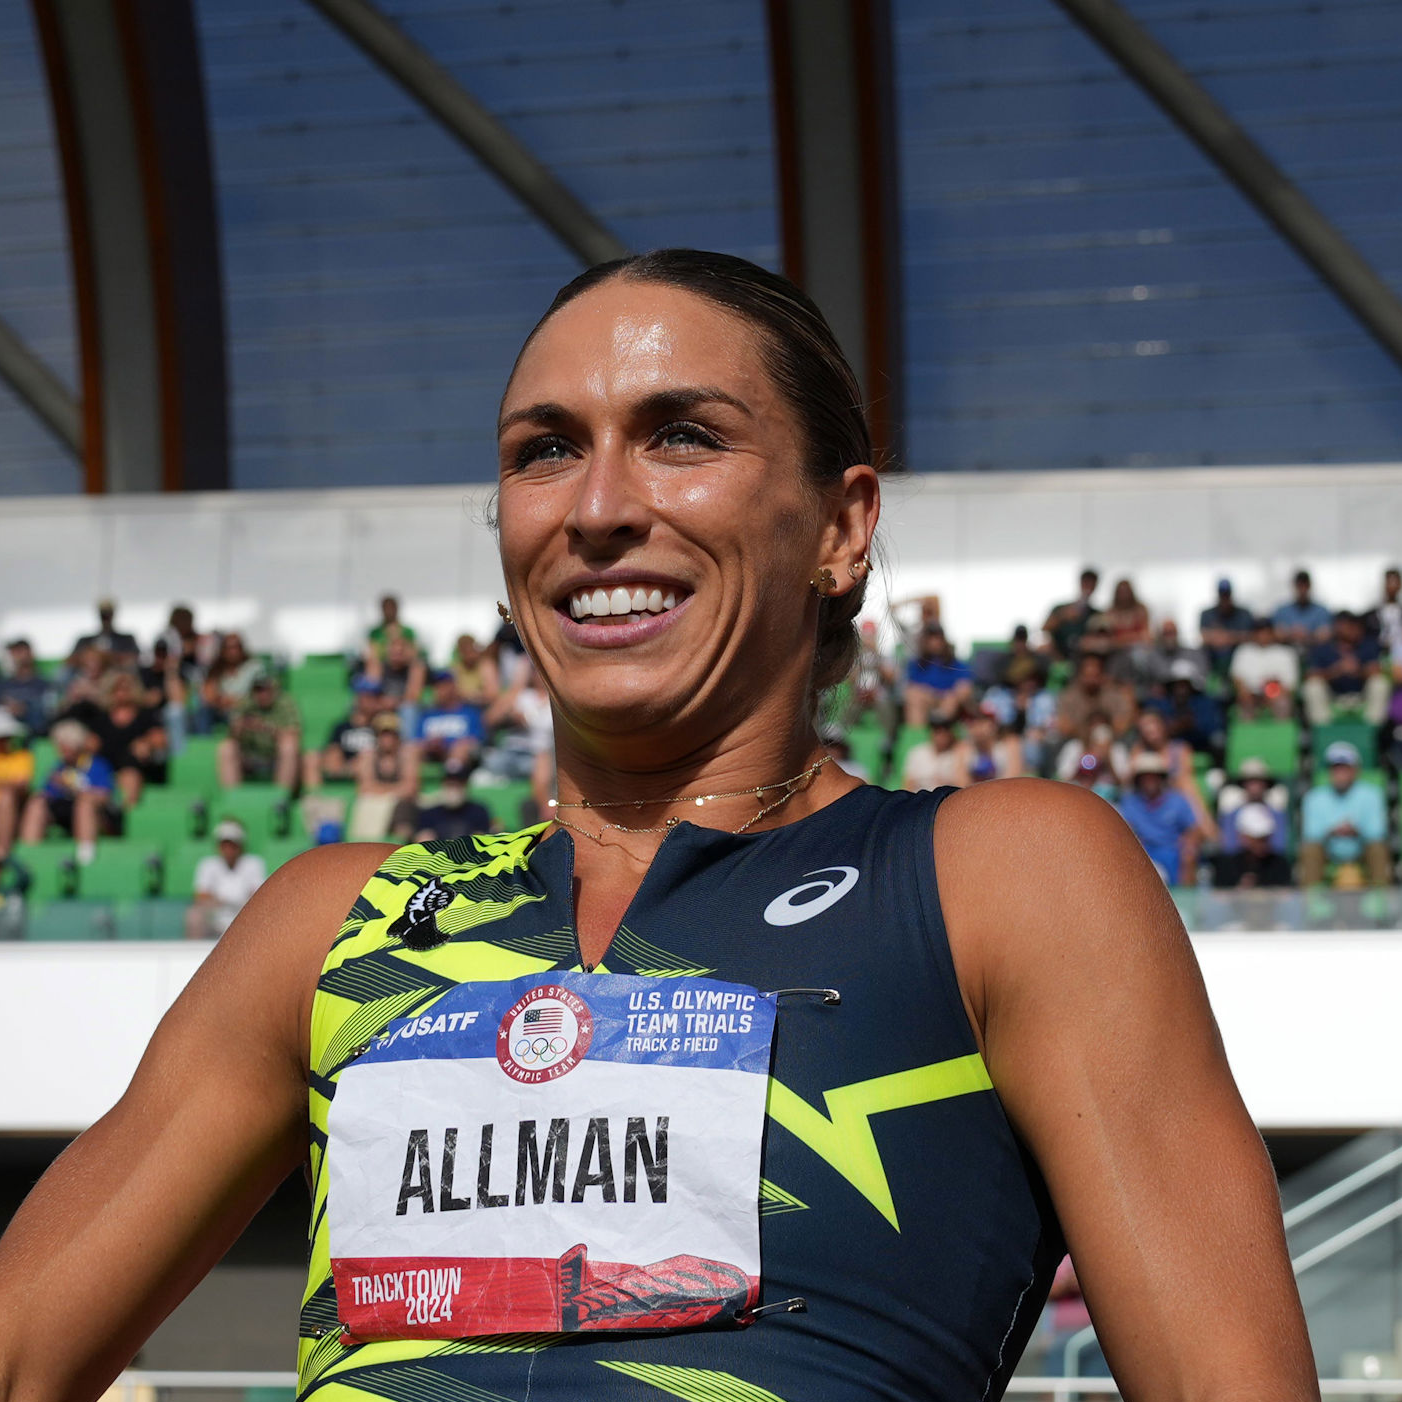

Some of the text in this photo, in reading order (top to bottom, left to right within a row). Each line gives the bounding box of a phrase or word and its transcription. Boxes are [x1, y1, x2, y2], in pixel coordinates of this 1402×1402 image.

[509, 987, 584, 1017] UNITED STATES
[628, 990, 756, 1012] U.S. OLYMPIC
[399, 1010, 480, 1039] USATF
[626, 1013, 753, 1034] TEAM TRIALS
[626, 1037, 719, 1052] TRACK & FIELD
[503, 1056, 576, 1082] OLYMPIC TEAM
[395, 1116, 670, 1216] ALLMAN
[351, 1267, 462, 1306] TRACKTOWN
[405, 1294, 453, 1326] 2024
